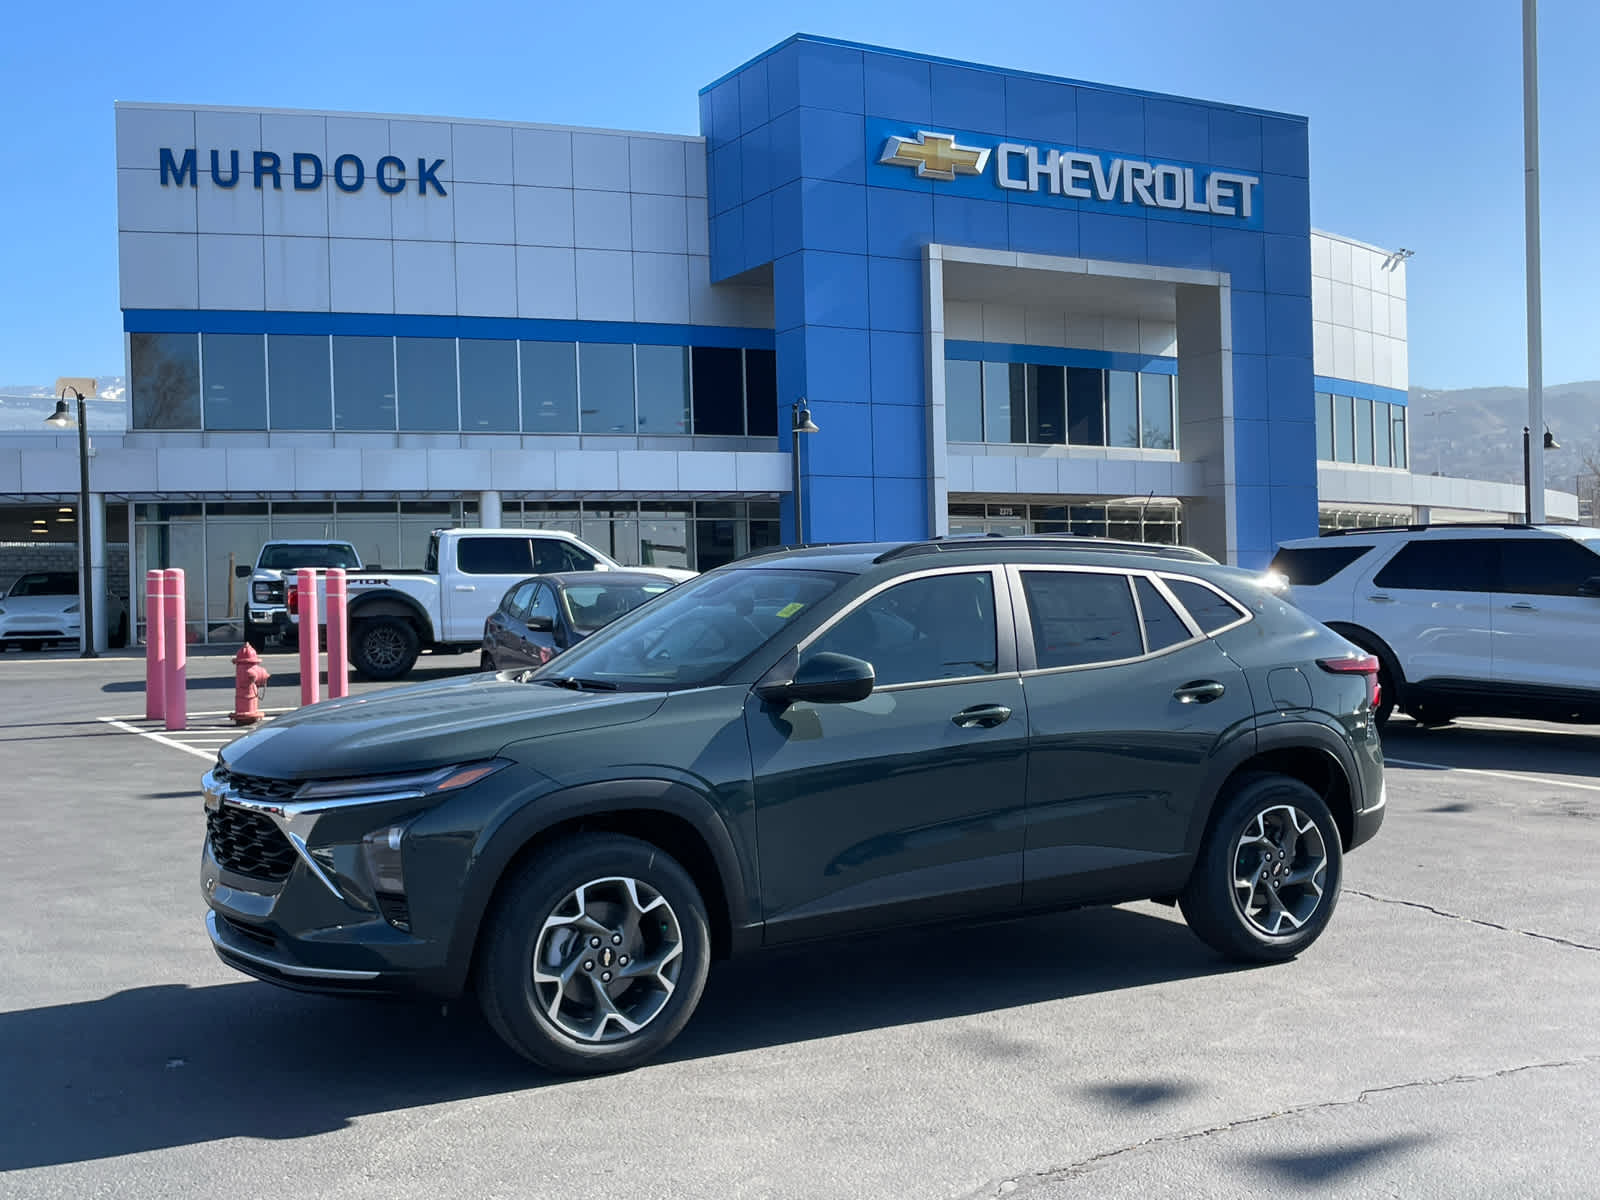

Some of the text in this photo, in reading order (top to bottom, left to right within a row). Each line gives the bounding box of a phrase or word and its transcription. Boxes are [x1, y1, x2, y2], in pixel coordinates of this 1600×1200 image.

[159, 147, 448, 197] MURDOCK
[996, 142, 1259, 217] CHEVROLET
[345, 578, 391, 586] PTOR
